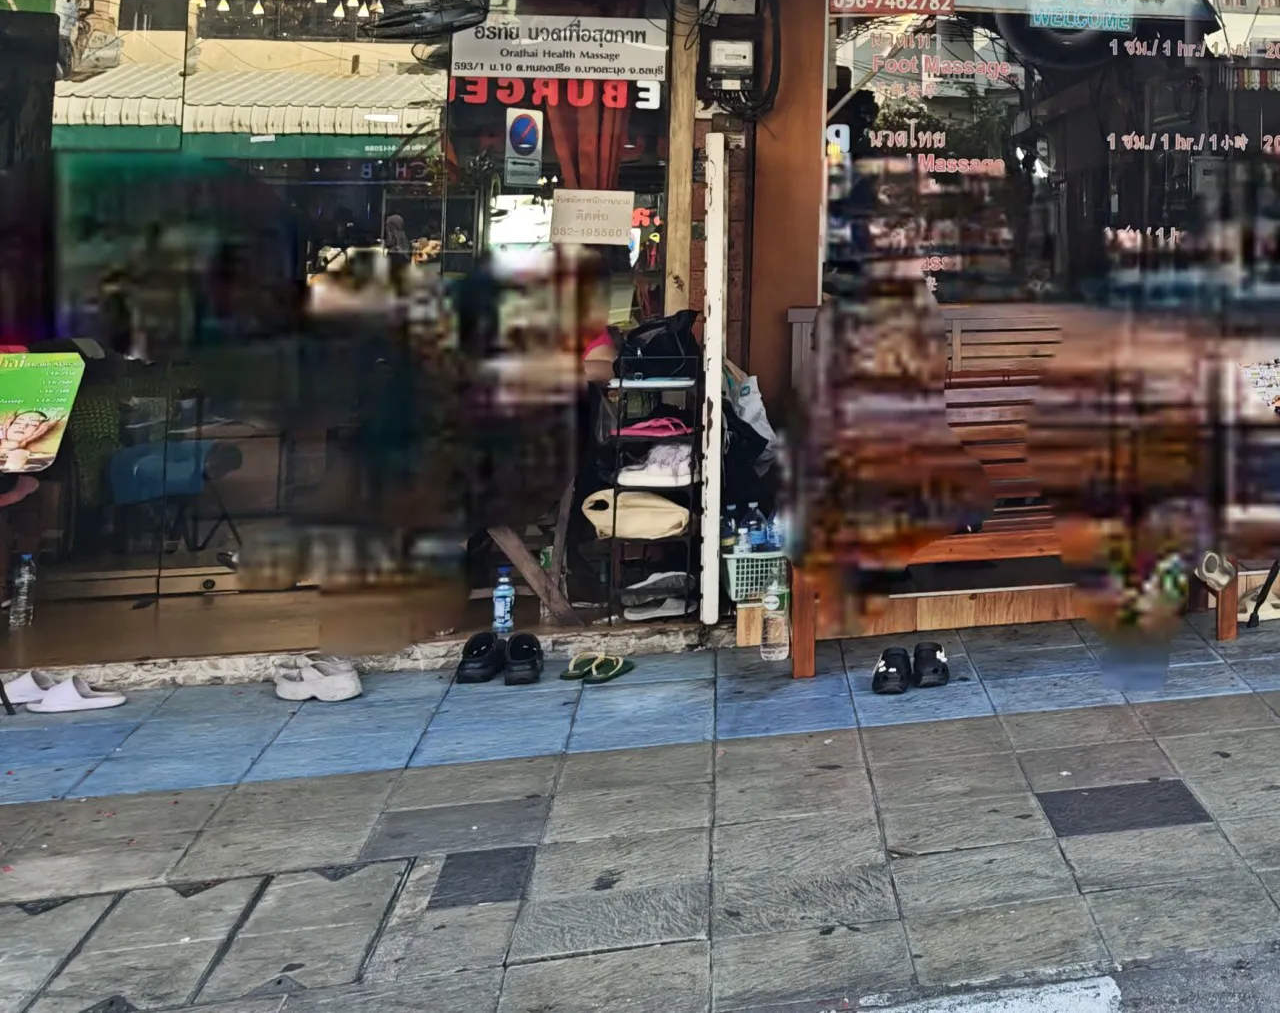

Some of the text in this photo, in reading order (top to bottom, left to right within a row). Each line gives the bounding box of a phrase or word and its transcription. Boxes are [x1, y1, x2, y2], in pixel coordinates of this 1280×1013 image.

[1032, 9, 1131, 30] WELCOME
[474, 19, 648, 48] อรทัย นวดเพื่อสุขภาพ
[500, 48, 621, 61] Orathai Health Massage
[453, 61, 485, 72] 593/1
[872, 54, 1012, 80] Foot Massage
[868, 117, 947, 149] นวดไทย
[1106, 133, 1116, 150] 1
